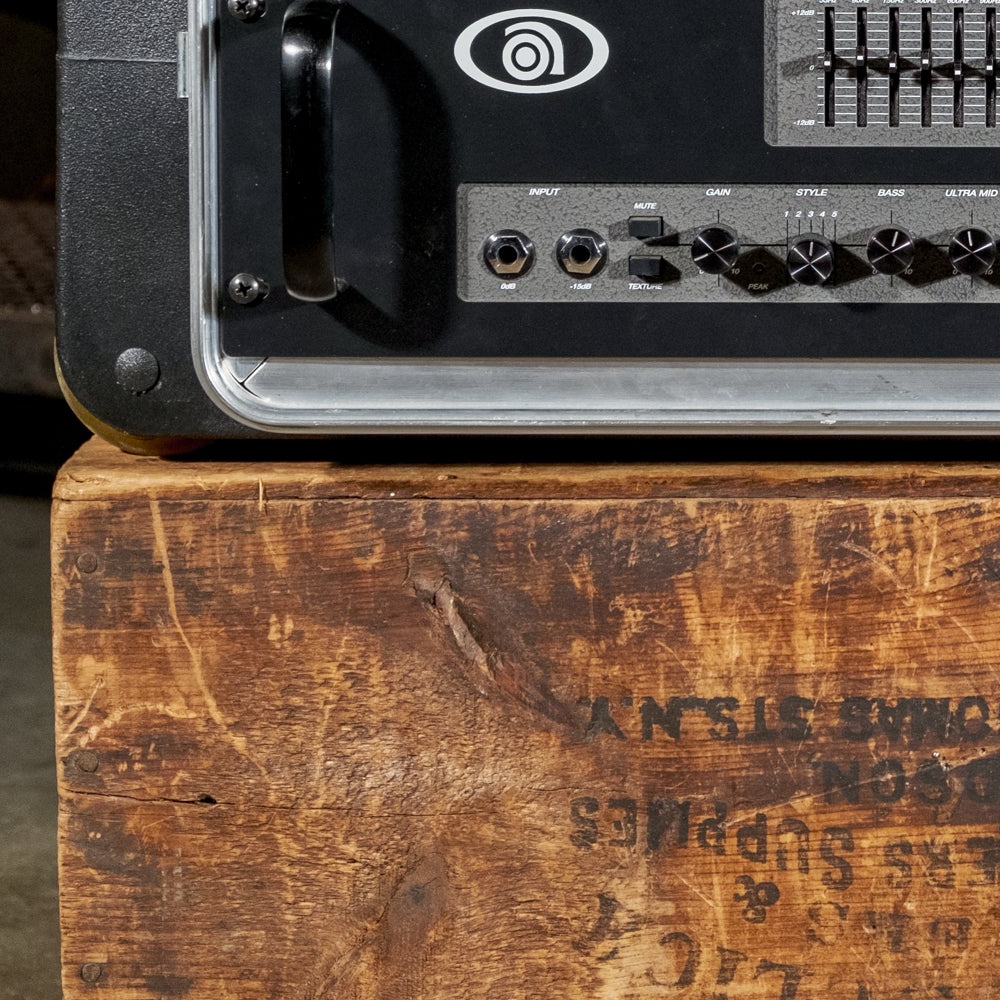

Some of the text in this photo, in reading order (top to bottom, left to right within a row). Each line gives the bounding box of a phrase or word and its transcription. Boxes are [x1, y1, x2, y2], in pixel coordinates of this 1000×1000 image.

[528, 188, 560, 196] INPUT
[706, 188, 731, 196] GAIN
[878, 189, 905, 197] BASS
[945, 189, 999, 197] ULTRA MID
[633, 202, 657, 210] MUTE
